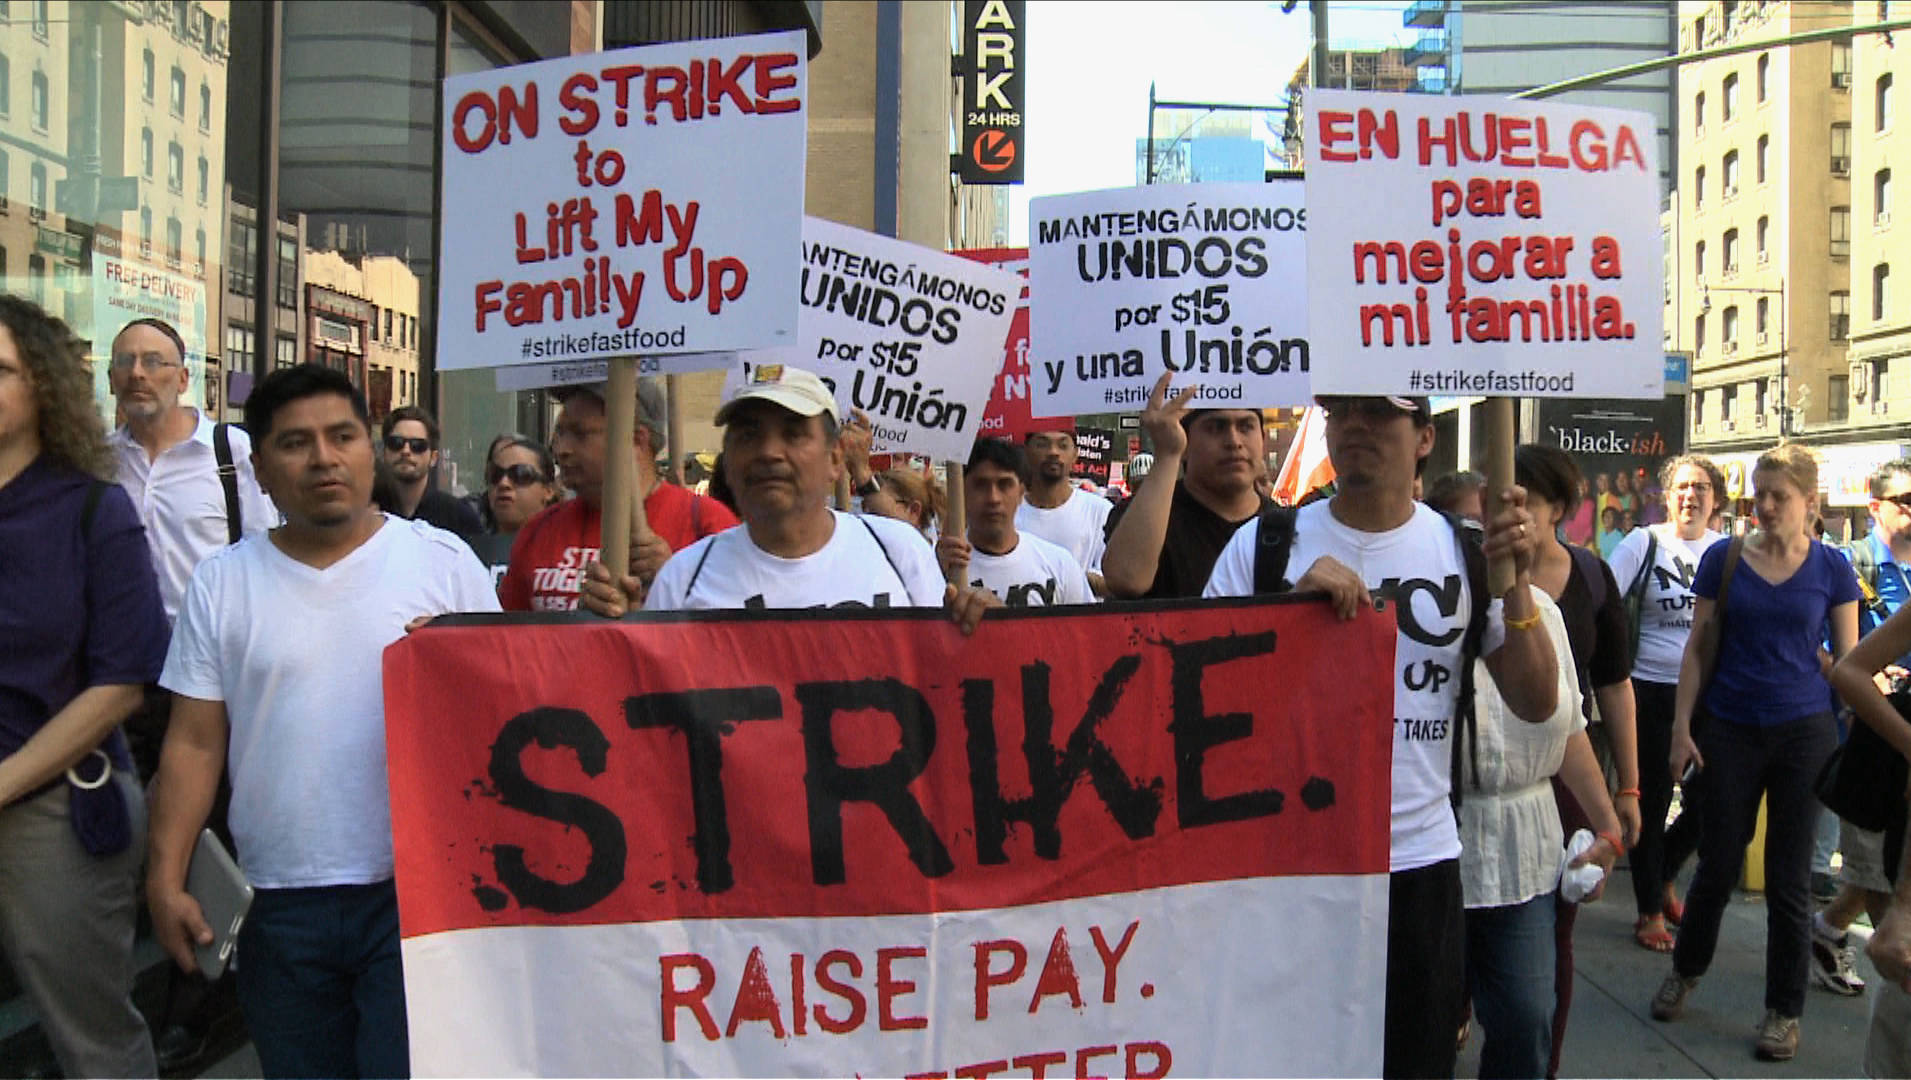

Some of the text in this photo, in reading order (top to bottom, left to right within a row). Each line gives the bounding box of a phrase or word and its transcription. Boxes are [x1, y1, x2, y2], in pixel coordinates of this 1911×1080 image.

[453, 53, 801, 153] ON STRIKE
[968, 113, 1020, 126] 24 HRS
[574, 139, 626, 187] to
[1318, 107, 1648, 172] EN HUELGA
[515, 189, 700, 264] Lift My
[1431, 176, 1542, 227] para
[105, 261, 137, 287] FREE
[140, 271, 197, 301] DELIVERY
[802, 240, 1007, 316] NTENGÁMONOS
[1077, 236, 1269, 283] UNIDOS
[1353, 227, 1623, 296] mejorar a
[475, 247, 749, 332] Family Up
[800, 267, 962, 345] UNIDOS
[1115, 284, 1230, 332] por $15
[1360, 283, 1636, 347] mi familia.
[521, 326, 686, 358] #strikefastfood
[817, 337, 922, 377] por $15
[1045, 360, 1065, 395] y
[1076, 349, 1145, 382] una
[1160, 326, 1310, 376] Unión
[852, 369, 968, 433] Unión
[1104, 383, 1243, 404] #strikfafood
[1410, 370, 1574, 392] #strikefastfood
[1403, 657, 1451, 694] UP
[1403, 718, 1449, 742] TAKES
[472, 628, 1336, 914] STRIKE.
[658, 919, 1155, 1044] RAISE PAY.
